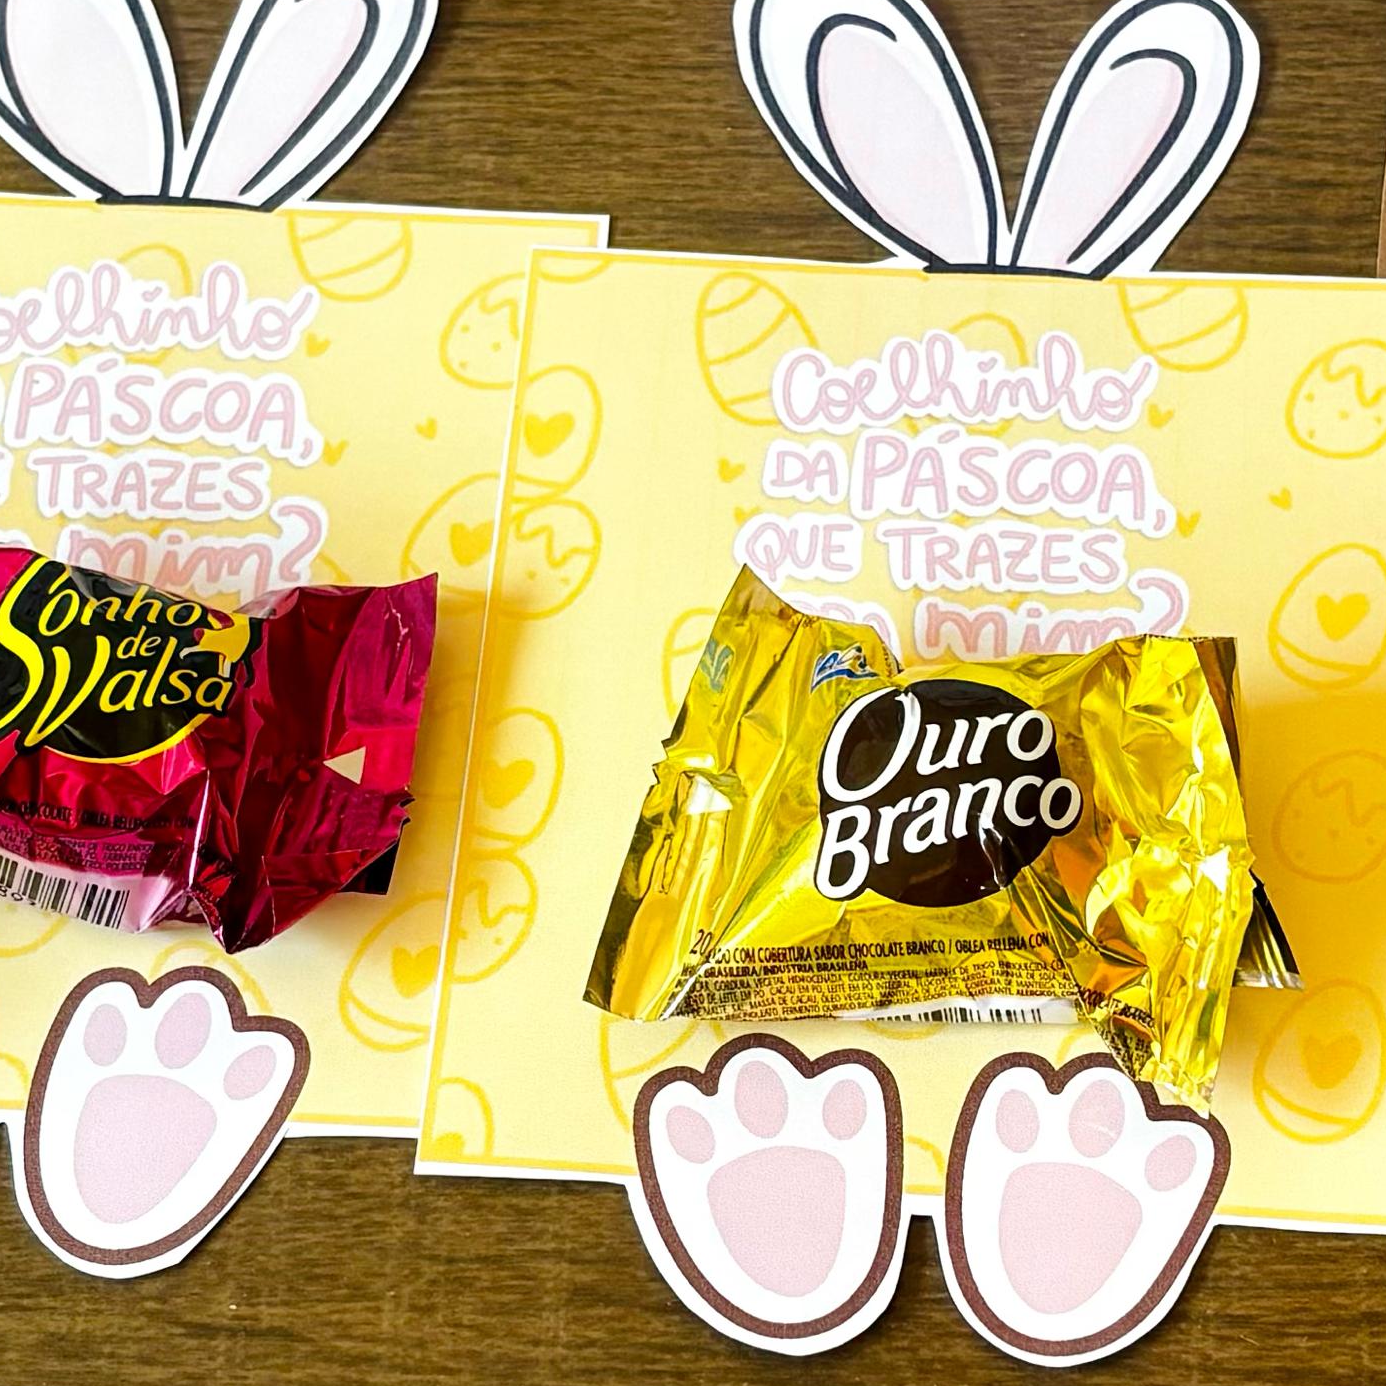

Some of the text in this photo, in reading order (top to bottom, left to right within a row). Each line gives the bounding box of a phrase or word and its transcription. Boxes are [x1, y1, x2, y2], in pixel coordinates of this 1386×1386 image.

[13, 359, 317, 462] PÁSCOA,
[780, 333, 1153, 427] Coelhinho
[32, 455, 265, 512] TRAZES
[768, 433, 1171, 536] DA PÁSCOA,
[744, 522, 1124, 587] QUE TRAZES
[23, 634, 235, 748] Valsa
[116, 625, 162, 660] de
[824, 687, 1057, 804] Ouro
[817, 773, 1082, 901] Branco
[757, 944, 813, 964] COBERTURA
[813, 943, 847, 962] SABOR
[847, 940, 905, 960] CHOCOLATE
[905, 938, 946, 956] BRANCO
